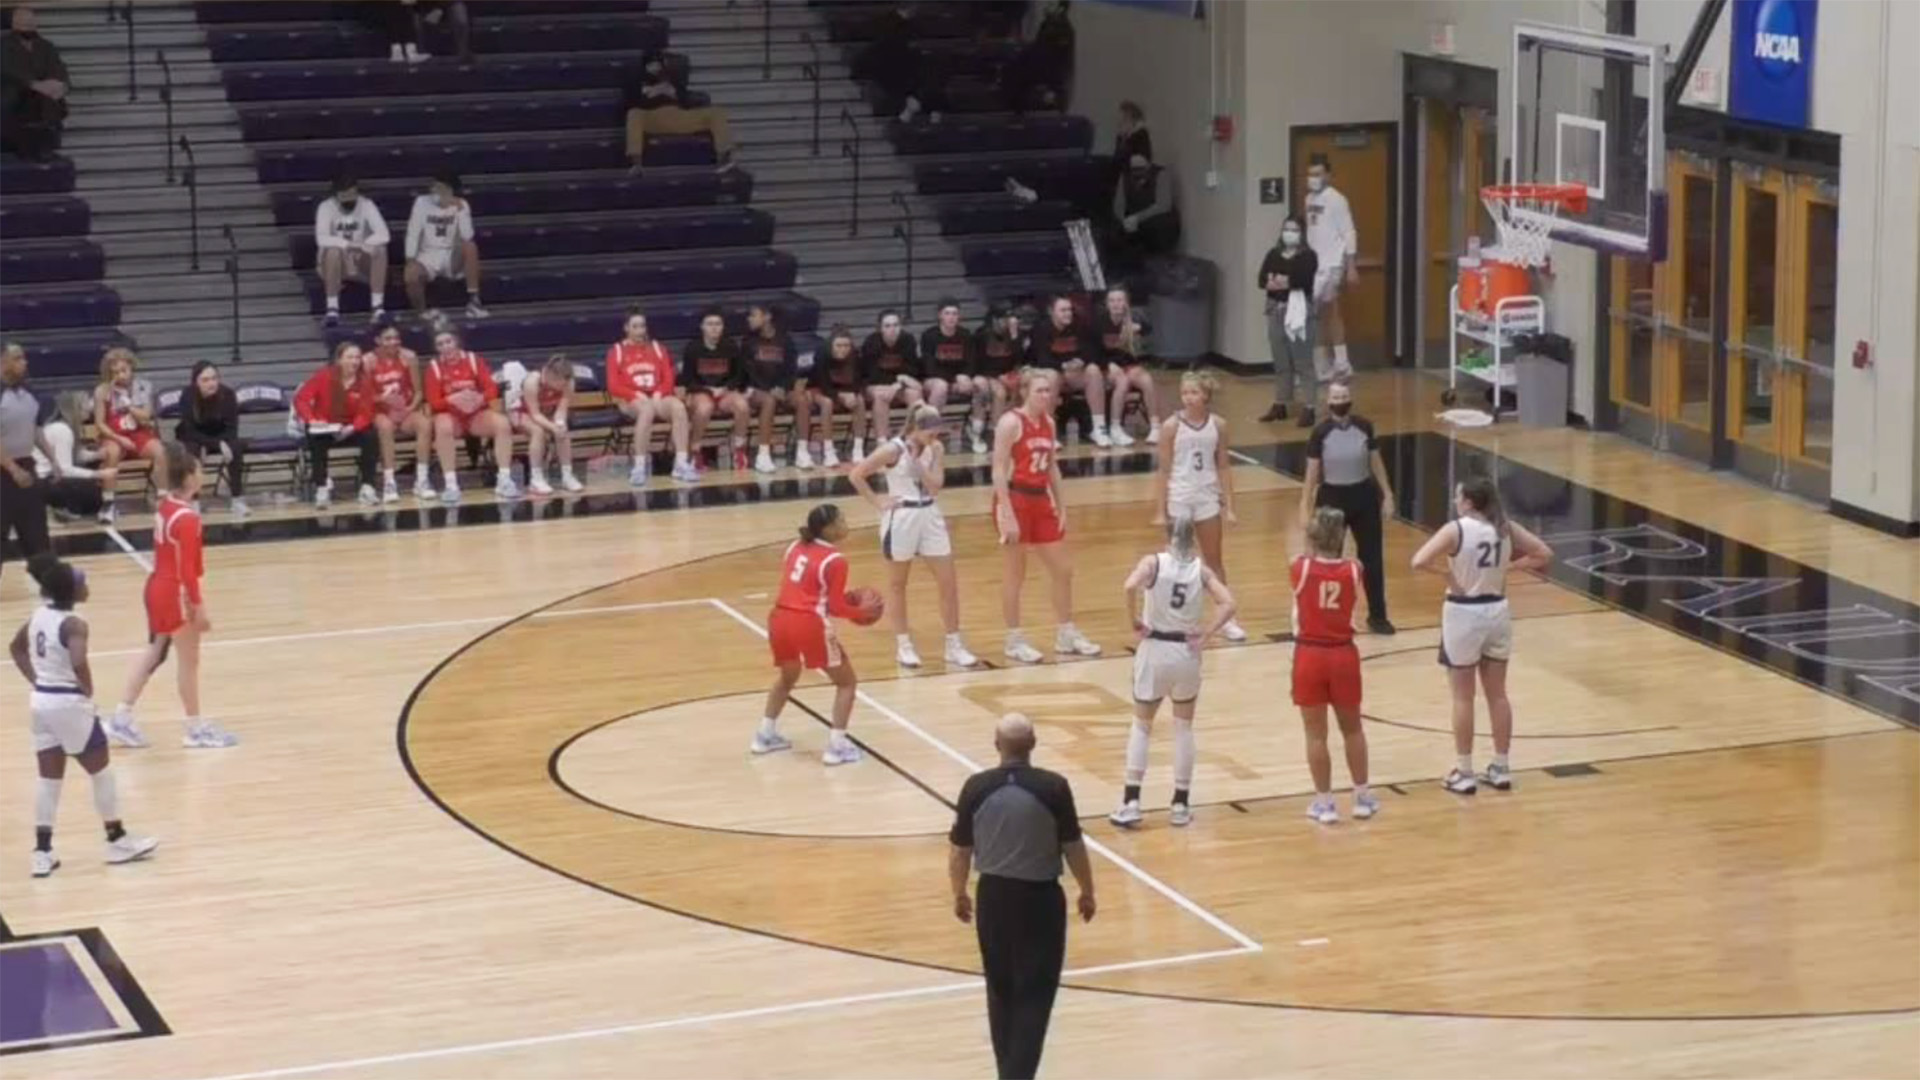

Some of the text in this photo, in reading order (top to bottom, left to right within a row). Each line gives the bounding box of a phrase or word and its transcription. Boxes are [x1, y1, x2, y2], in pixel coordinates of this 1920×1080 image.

[1754, 32, 1801, 63] NCAA
[1193, 451, 1204, 472] 3
[790, 554, 809, 582] 5
[1476, 541, 1502, 568] 21
[1169, 582, 1189, 609] 5
[1318, 580, 1341, 609] 12
